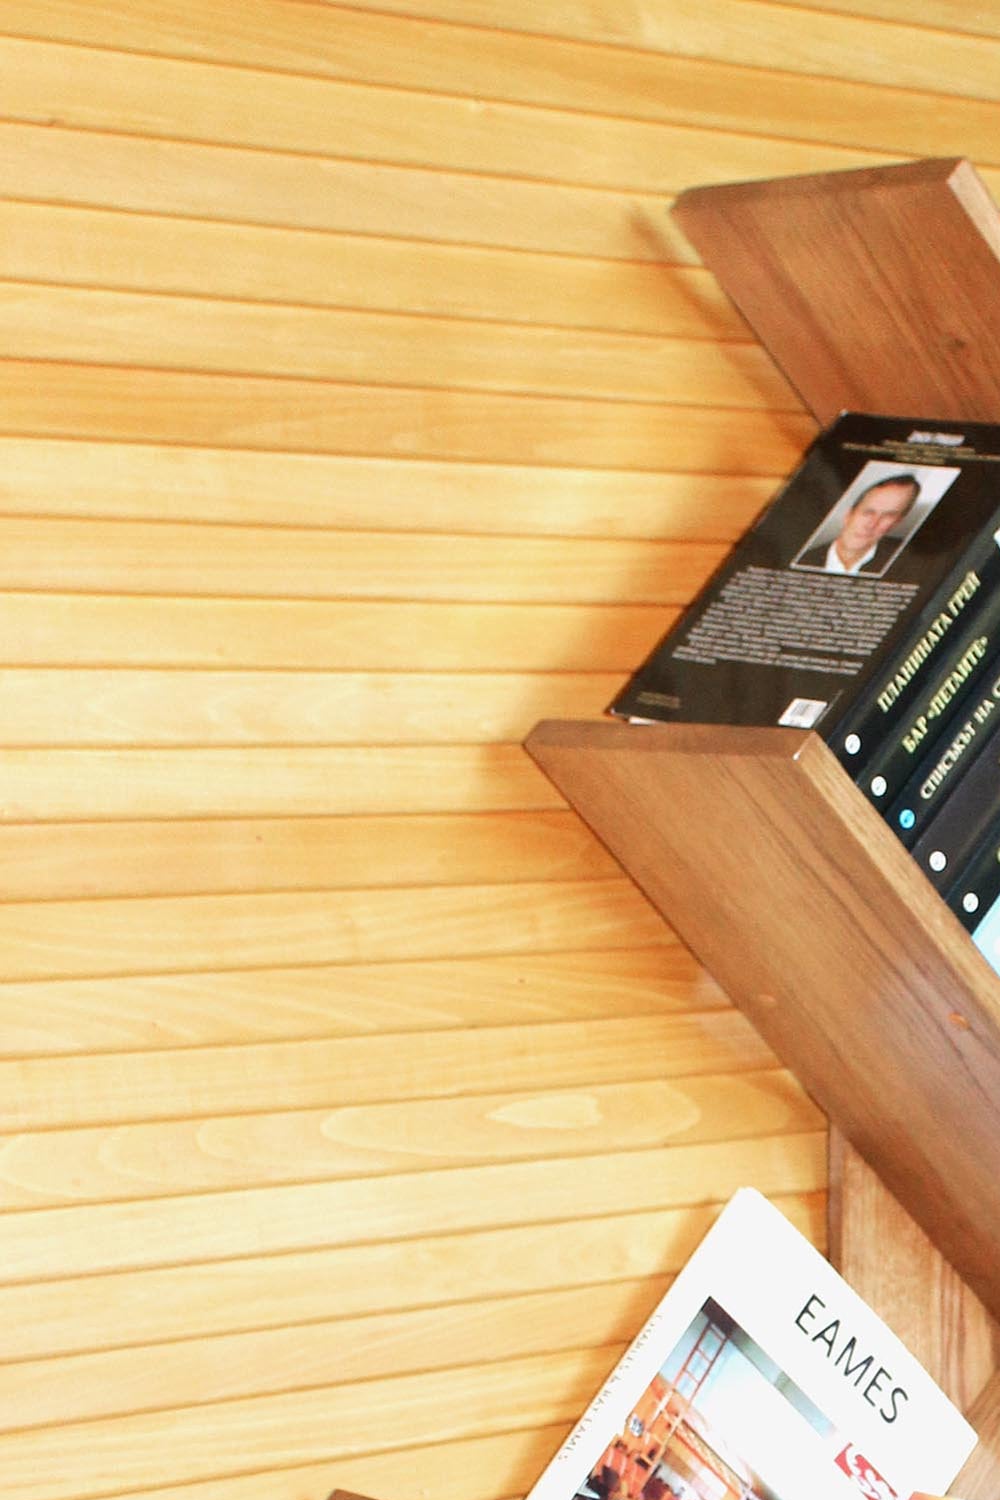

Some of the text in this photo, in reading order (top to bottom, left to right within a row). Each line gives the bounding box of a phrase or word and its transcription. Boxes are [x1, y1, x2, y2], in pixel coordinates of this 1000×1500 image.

[878, 610, 949, 713] ПЛАНИНАТА
[903, 714, 928, 754] БАР
[920, 719, 976, 801] СПИСЪКЪТ
[975, 697, 992, 724] НА
[796, 1295, 910, 1424] EAMES
